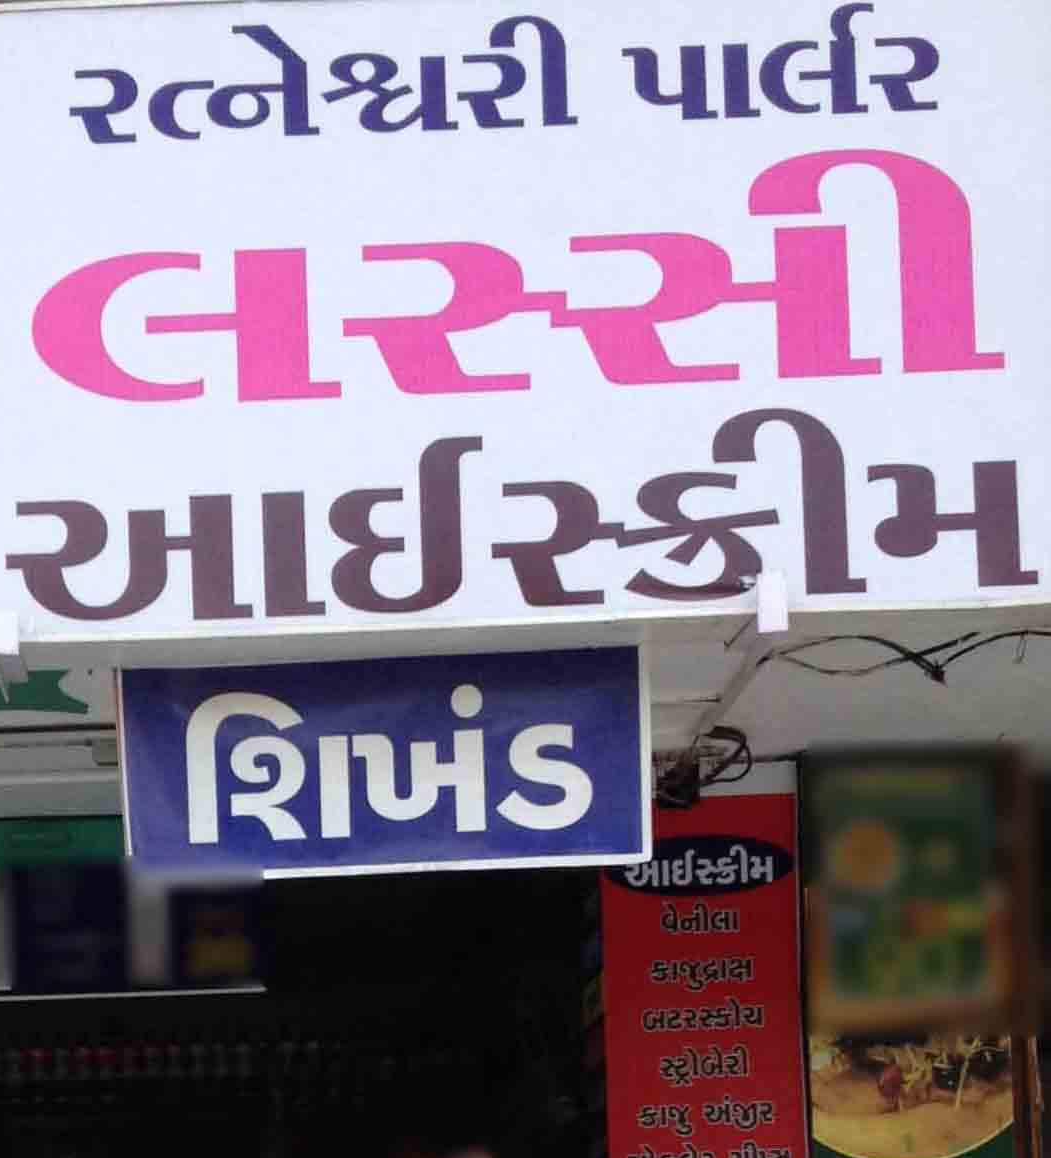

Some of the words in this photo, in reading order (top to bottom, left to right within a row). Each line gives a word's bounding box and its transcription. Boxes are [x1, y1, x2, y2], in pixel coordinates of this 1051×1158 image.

[69, 15, 578, 144] રત્નેશ્વરી
[622, 2, 940, 120] પાર્લર
[31, 148, 1005, 403] લસ્સી
[5, 408, 1039, 621] આઈસ્ક્રીમ
[186, 684, 594, 844] શિખંડ
[638, 1103, 693, 1137] કાજુ
[704, 1094, 774, 1130] અંજીર
